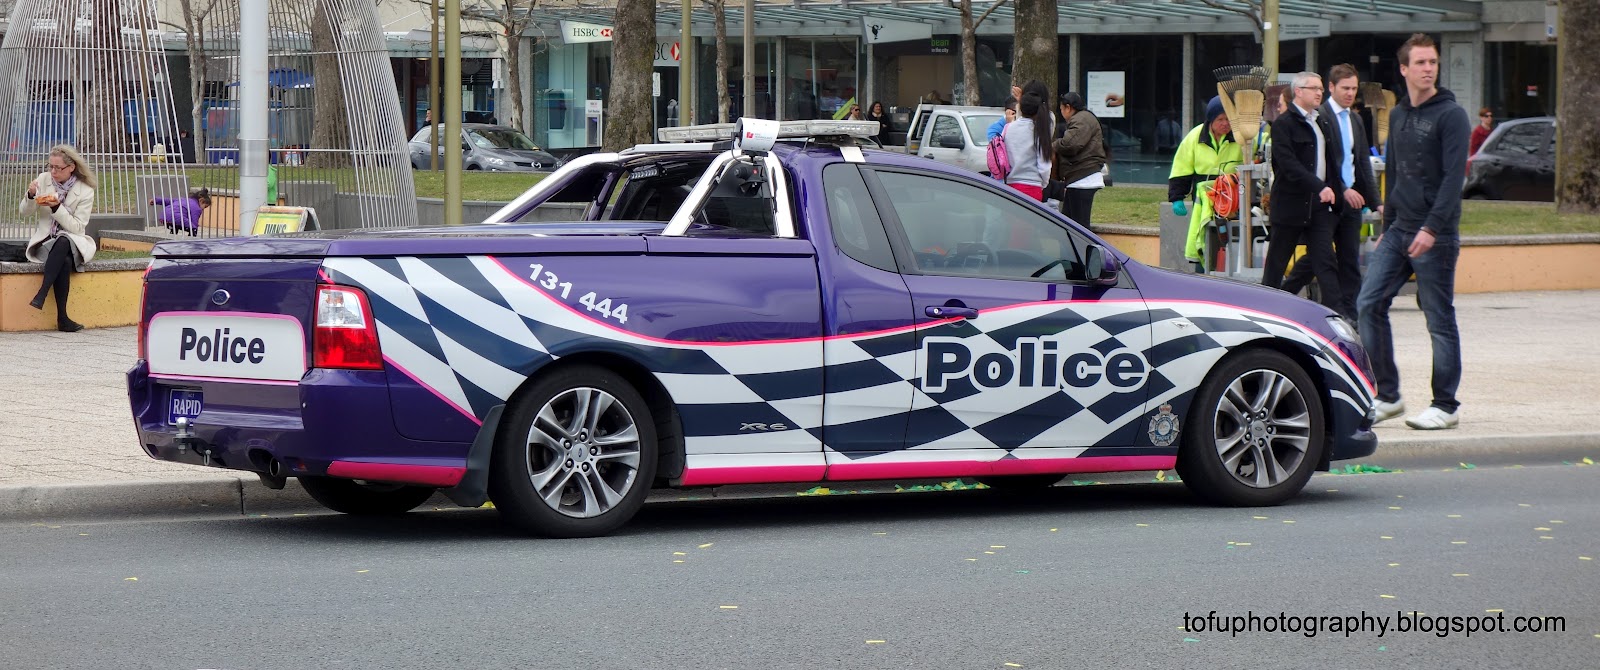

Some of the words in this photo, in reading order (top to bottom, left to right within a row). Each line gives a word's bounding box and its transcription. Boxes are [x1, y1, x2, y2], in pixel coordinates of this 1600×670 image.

[573, 28, 598, 37] HSBC
[654, 43, 669, 60] BC
[529, 263, 573, 300] 131
[579, 291, 628, 324] 444
[180, 327, 265, 364] Police
[925, 340, 1145, 388] Police
[173, 398, 202, 416] RAPID
[739, 422, 788, 431] XR6
